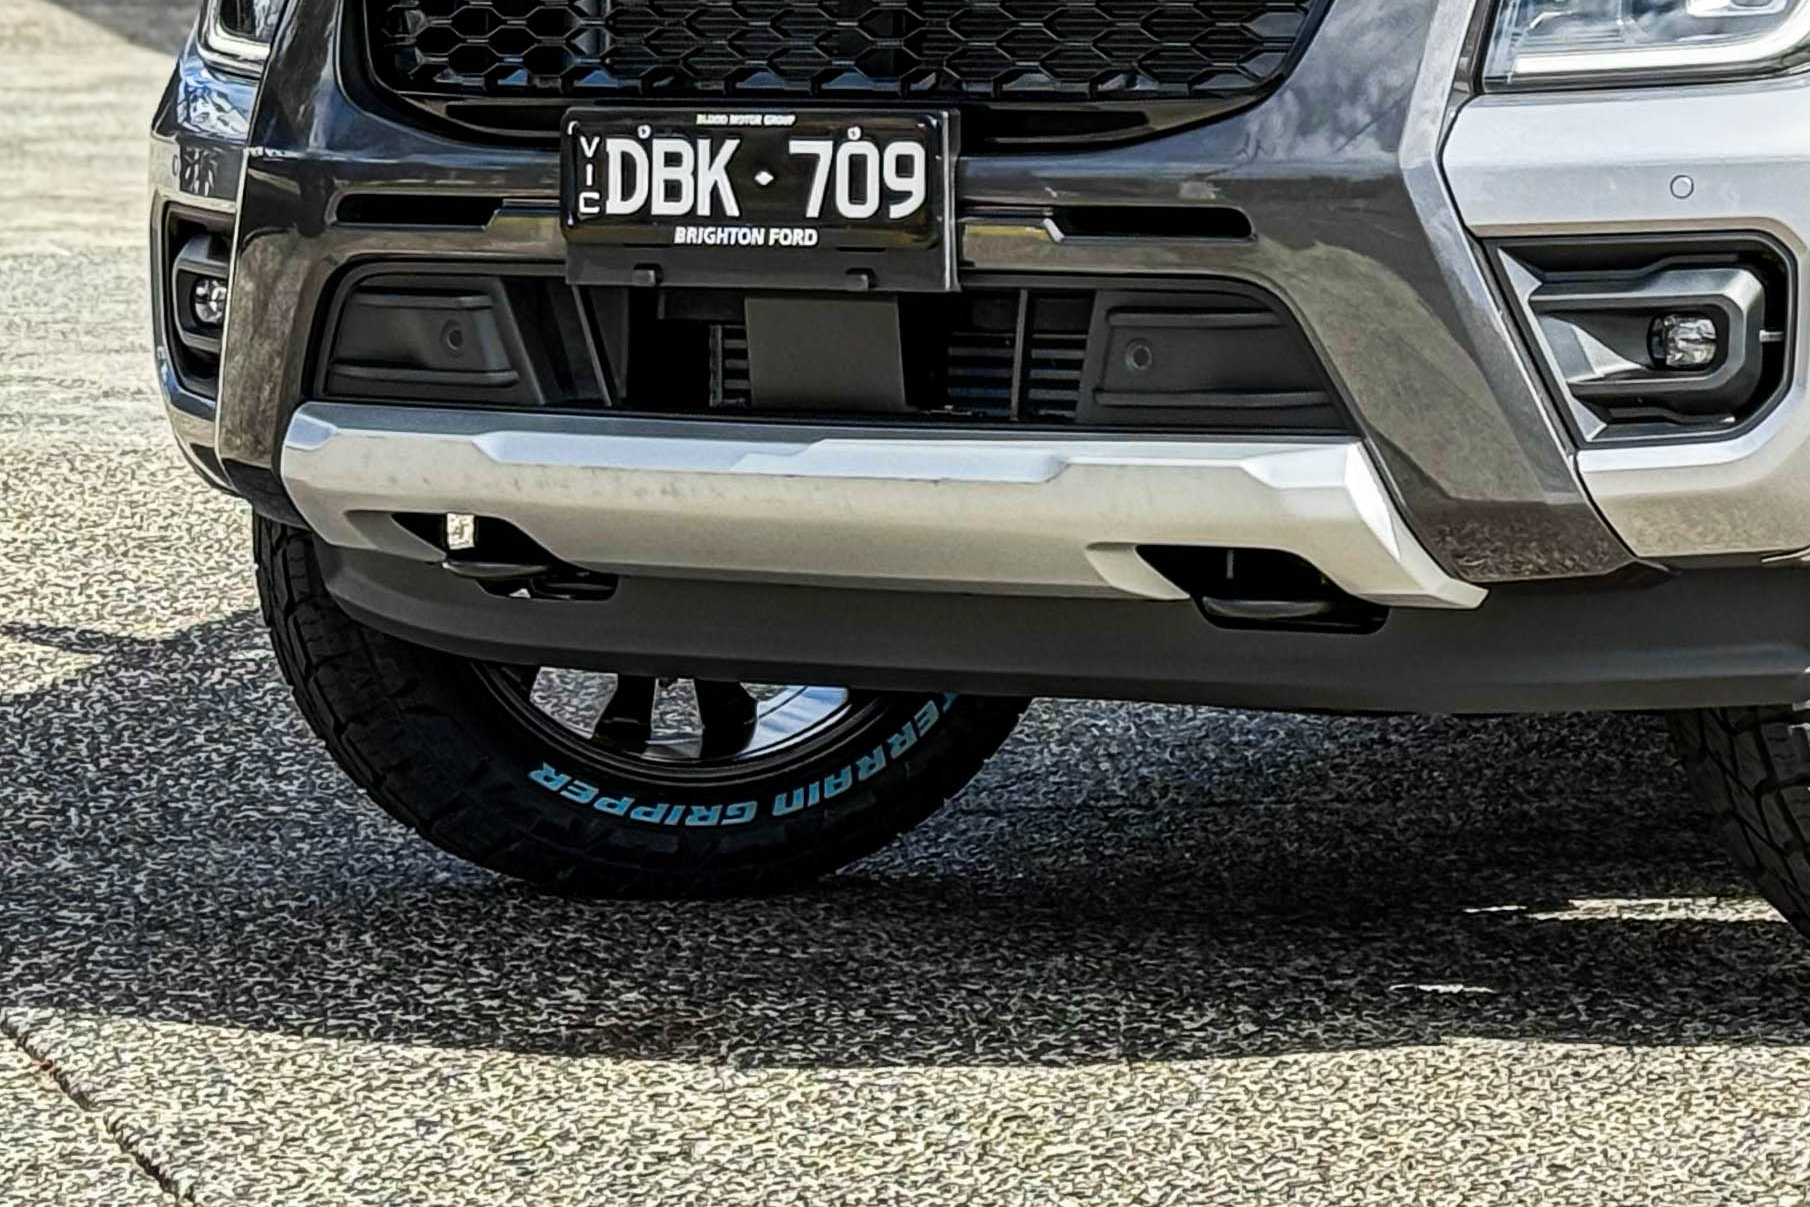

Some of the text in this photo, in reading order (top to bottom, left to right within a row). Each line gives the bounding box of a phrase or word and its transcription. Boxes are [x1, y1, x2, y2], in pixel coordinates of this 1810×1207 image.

[579, 136, 600, 214] VIC
[605, 137, 926, 220] DBK 709
[674, 226, 818, 247] BRIGHTON FORD
[528, 761, 758, 827] GRIPPER
